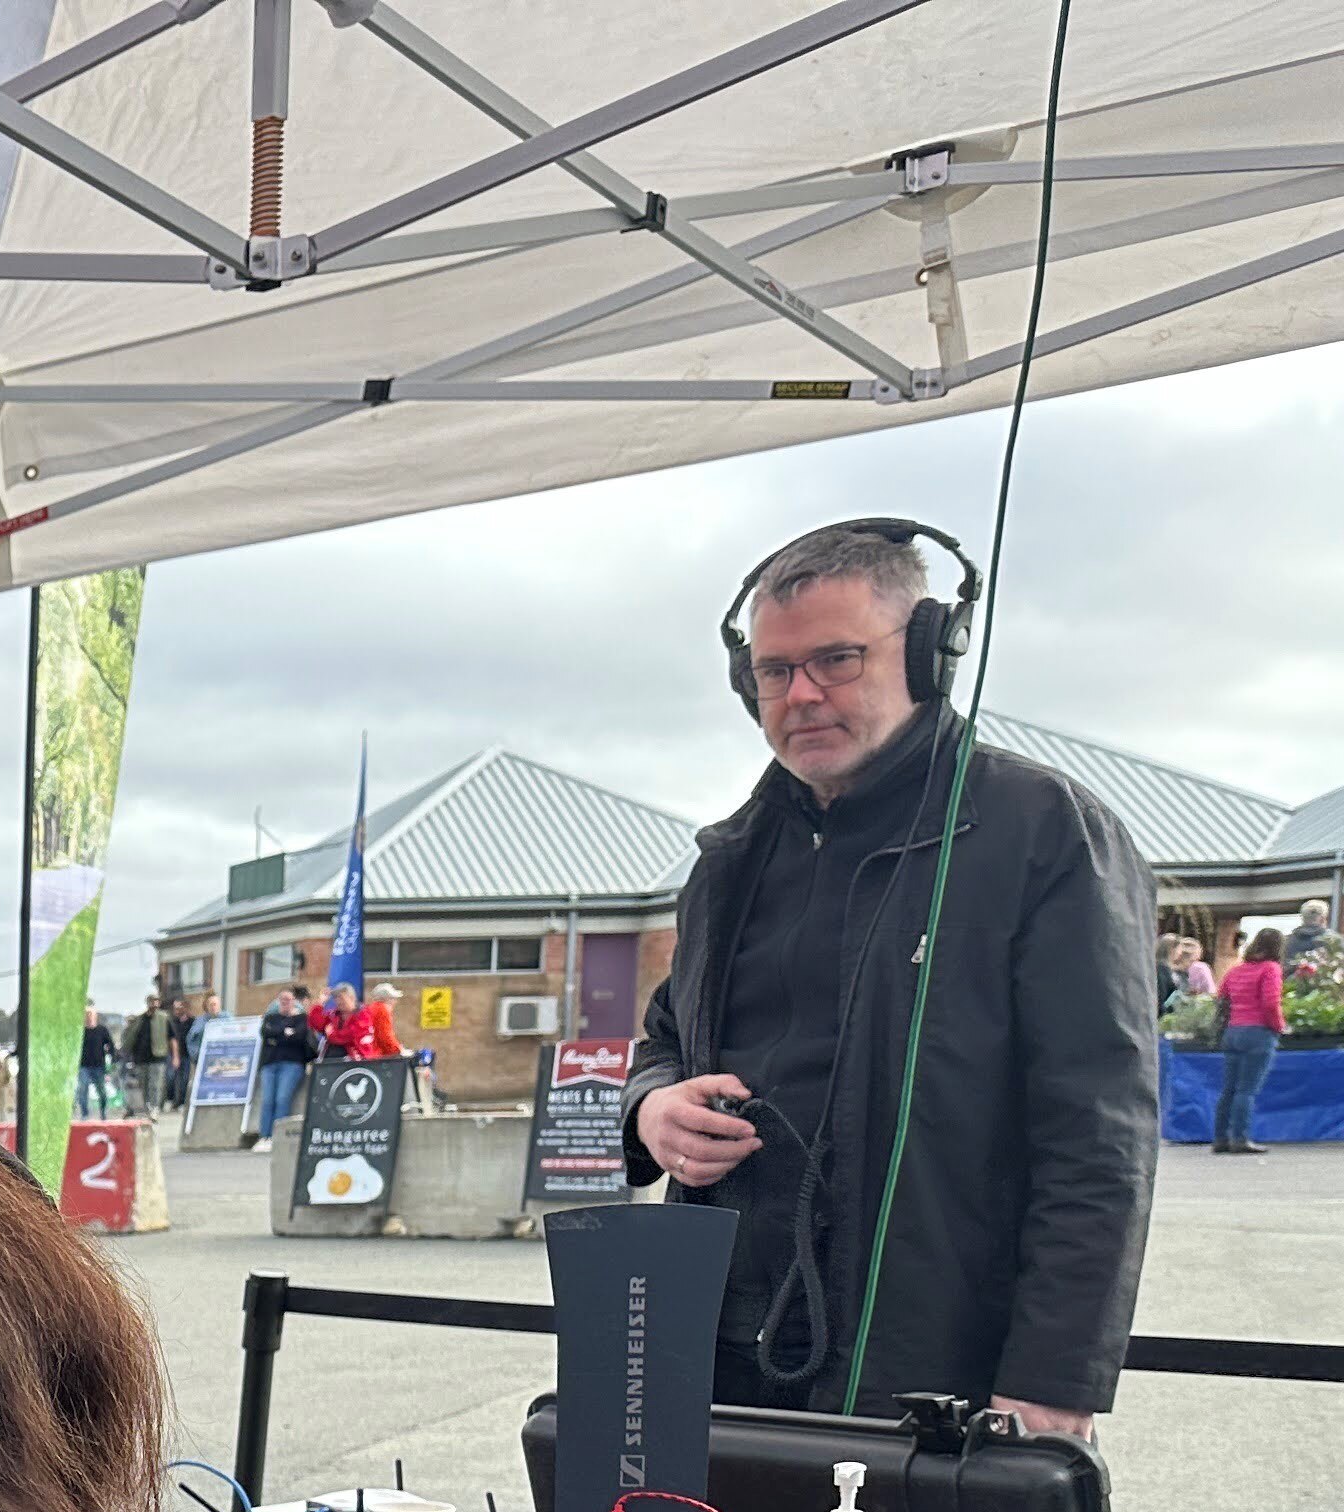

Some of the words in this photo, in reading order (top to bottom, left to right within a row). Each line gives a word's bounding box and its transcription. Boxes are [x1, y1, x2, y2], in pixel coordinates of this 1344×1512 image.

[79, 1131, 118, 1191] 2
[311, 1128, 390, 1144] Bungaree
[625, 1275, 647, 1446] SENNHEISER
